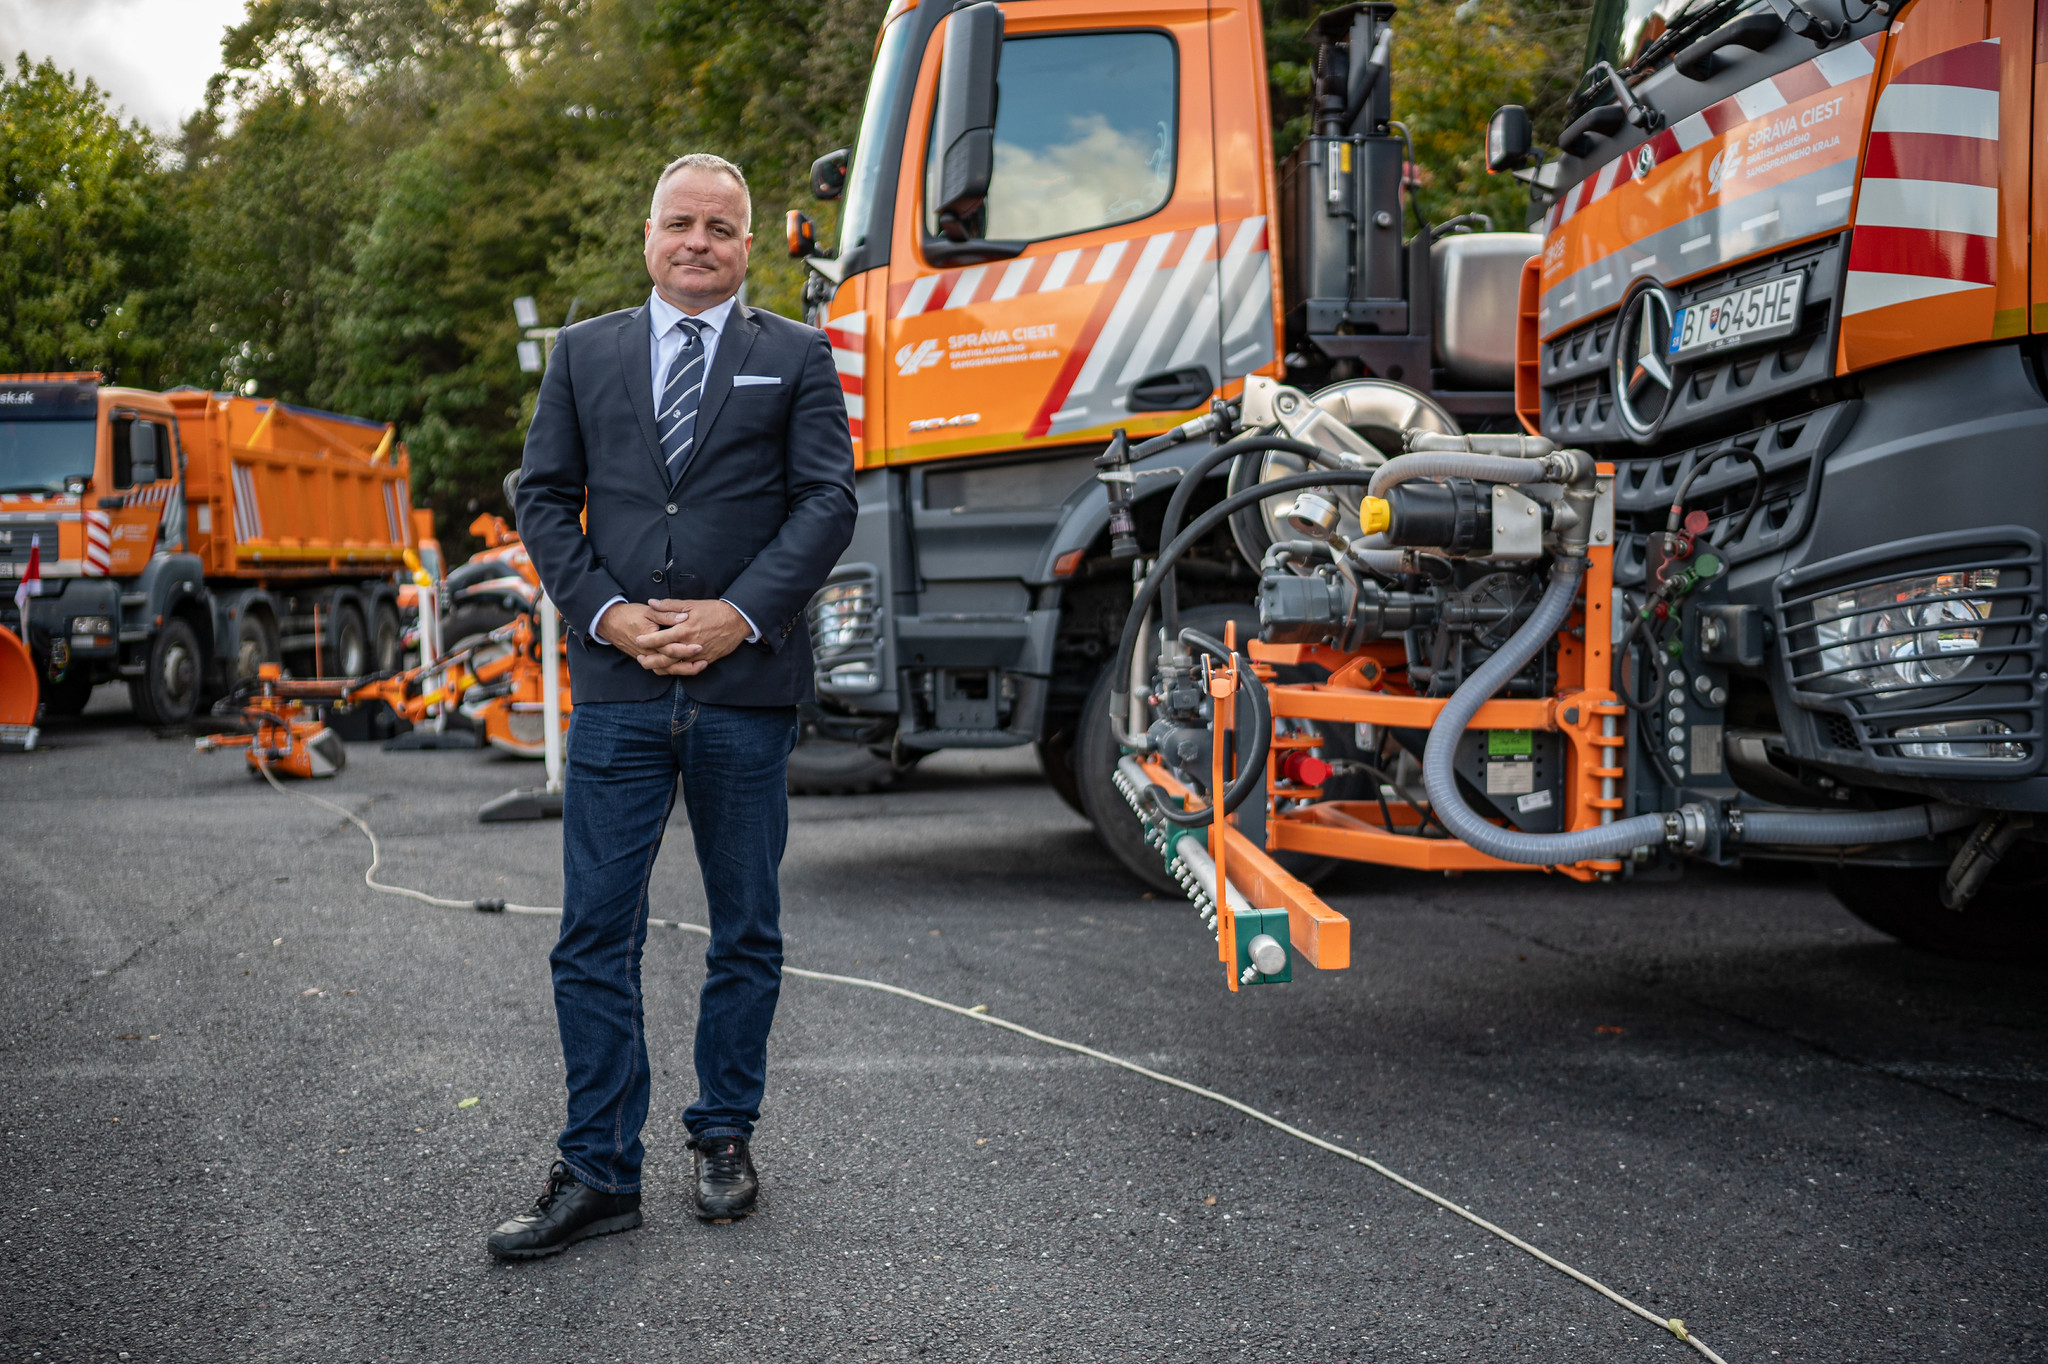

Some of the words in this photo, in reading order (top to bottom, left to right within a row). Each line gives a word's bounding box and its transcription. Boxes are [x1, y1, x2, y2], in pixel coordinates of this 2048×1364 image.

[1747, 117, 1798, 150] SPRÁVA
[1801, 97, 1843, 128] CIEST
[1812, 136, 1840, 153] KRAJA
[1681, 303, 1710, 347] BT
[1718, 279, 1797, 335] 645HE
[948, 329, 1009, 349] SPRÁVA
[1012, 324, 1056, 341] CIEST
[1029, 350, 1059, 359] KRAJA
